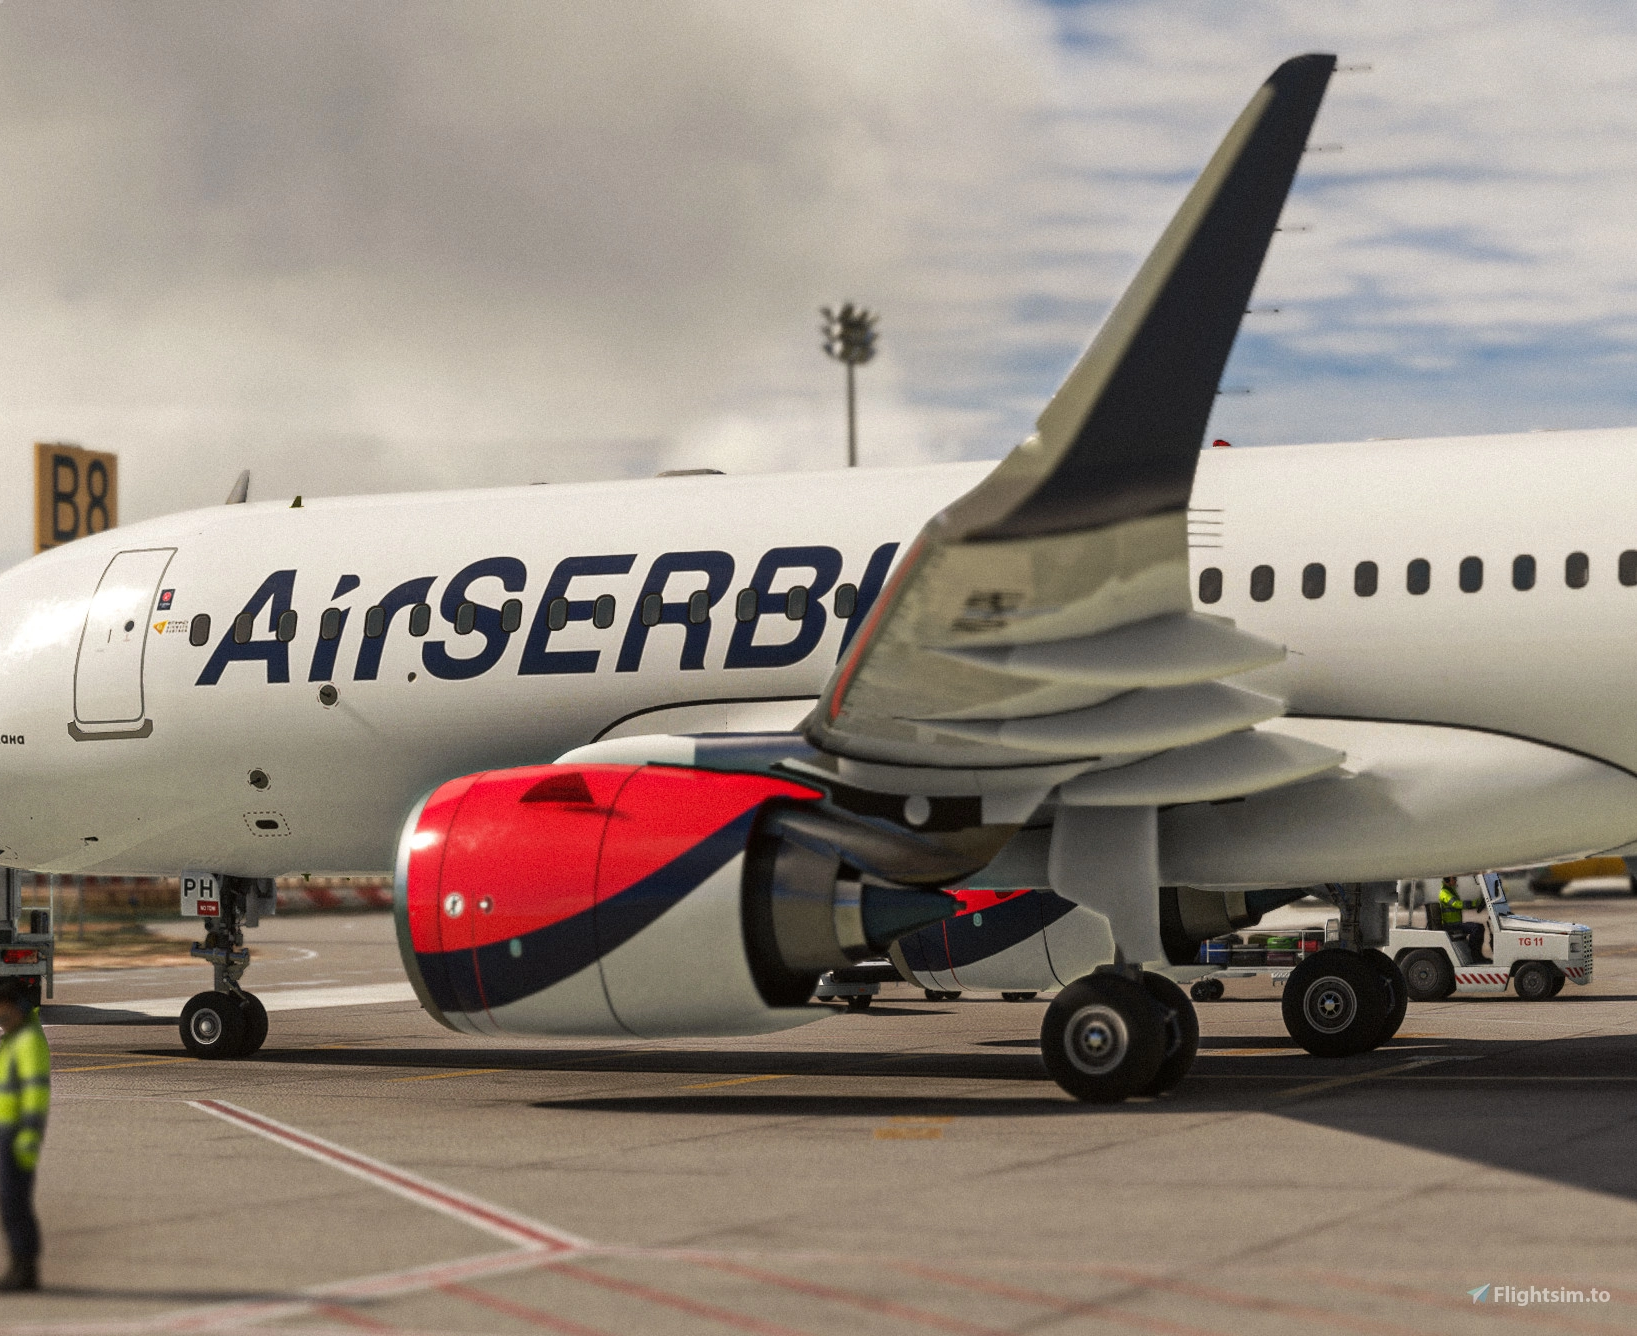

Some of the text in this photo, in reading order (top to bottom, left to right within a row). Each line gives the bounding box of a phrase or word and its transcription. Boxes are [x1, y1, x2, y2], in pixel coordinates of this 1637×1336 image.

[52, 453, 110, 542] B8
[184, 878, 213, 898] PH
[1518, 937, 1543, 946] TG 11
